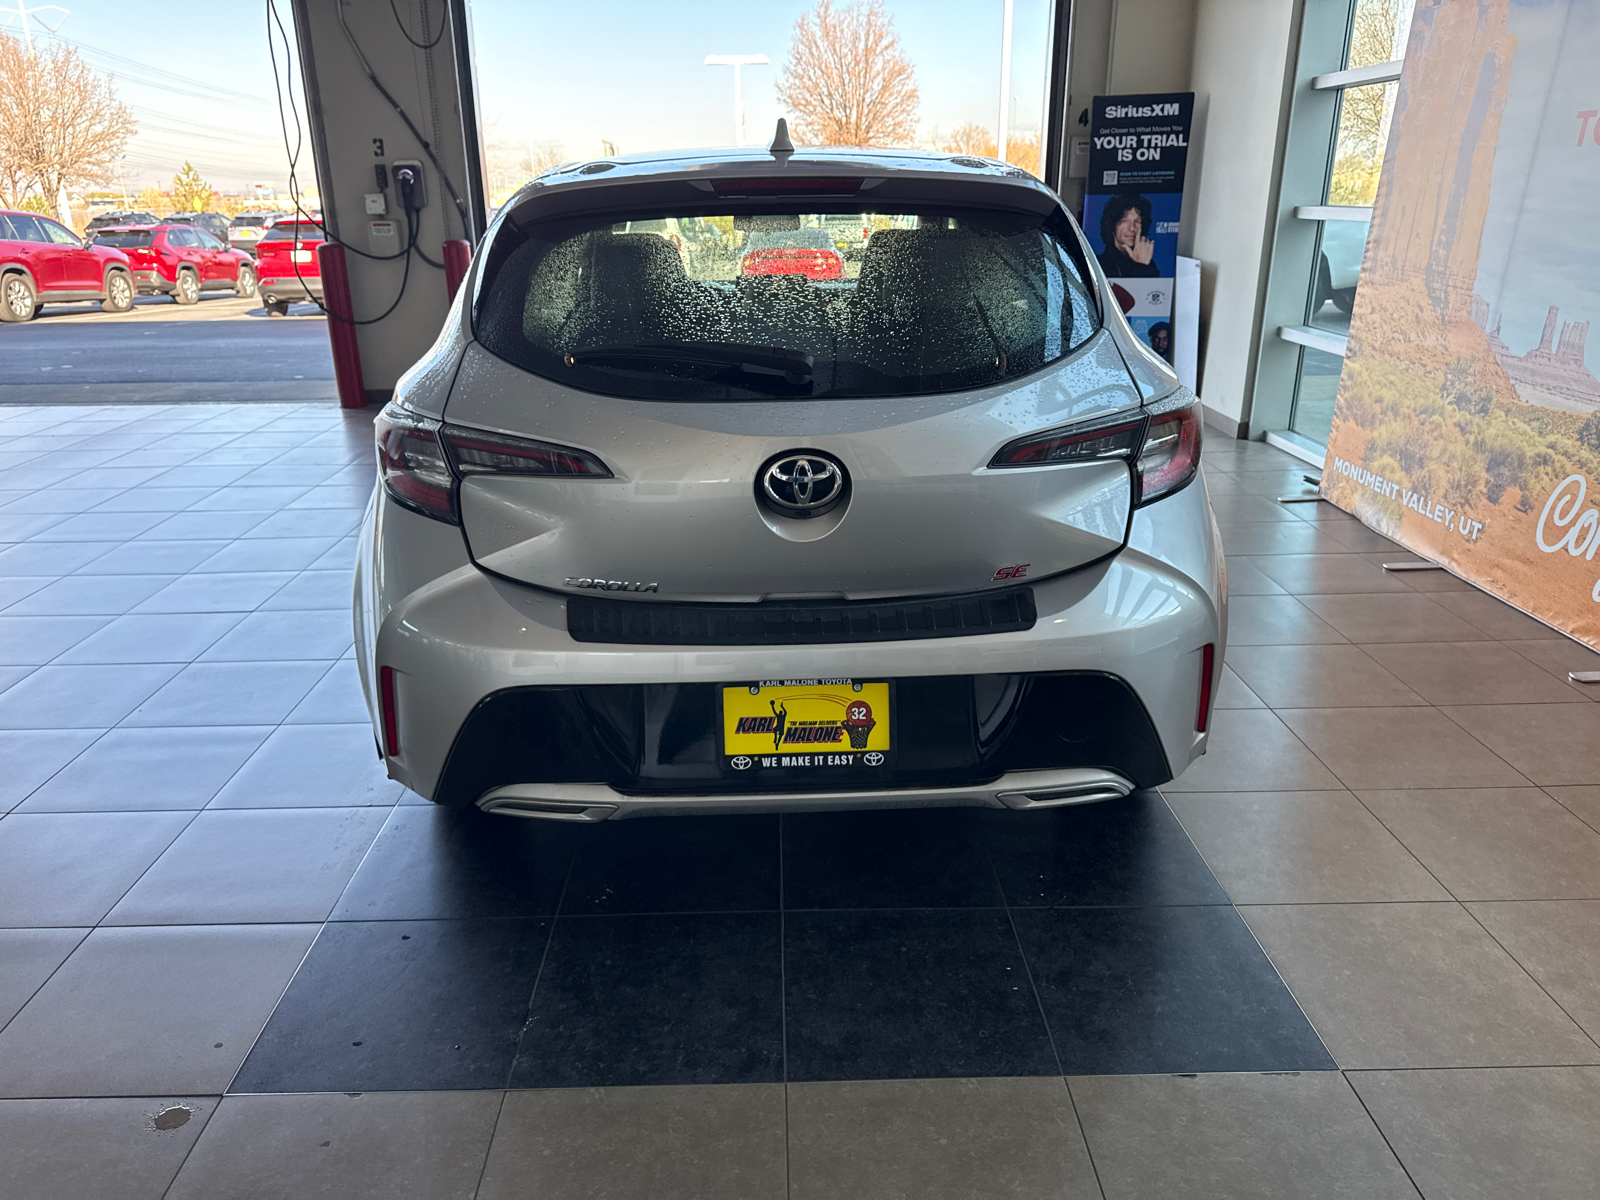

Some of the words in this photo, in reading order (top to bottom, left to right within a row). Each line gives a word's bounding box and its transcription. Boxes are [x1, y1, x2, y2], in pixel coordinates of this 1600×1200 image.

[1078, 108, 1089, 127] 4
[1105, 103, 1179, 119] SiriusXM
[372, 138, 384, 157] 3
[1093, 135, 1137, 150] YOUR
[1140, 134, 1188, 148] TRIAL
[1117, 149, 1133, 162] IS
[1136, 148, 1161, 161] ON
[1333, 456, 1400, 500] MONUMENT
[1402, 488, 1455, 532] VALLEY,
[1459, 515, 1483, 540] UT
[991, 562, 1032, 581] SE
[563, 577, 659, 593] COROLLA
[851, 707, 867, 720] 32
[735, 717, 776, 734] KARL
[783, 726, 843, 743] MALONE
[761, 757, 778, 768] WE
[781, 756, 811, 767] MAKE
[814, 755, 824, 766] IT
[827, 755, 854, 766] EASY
